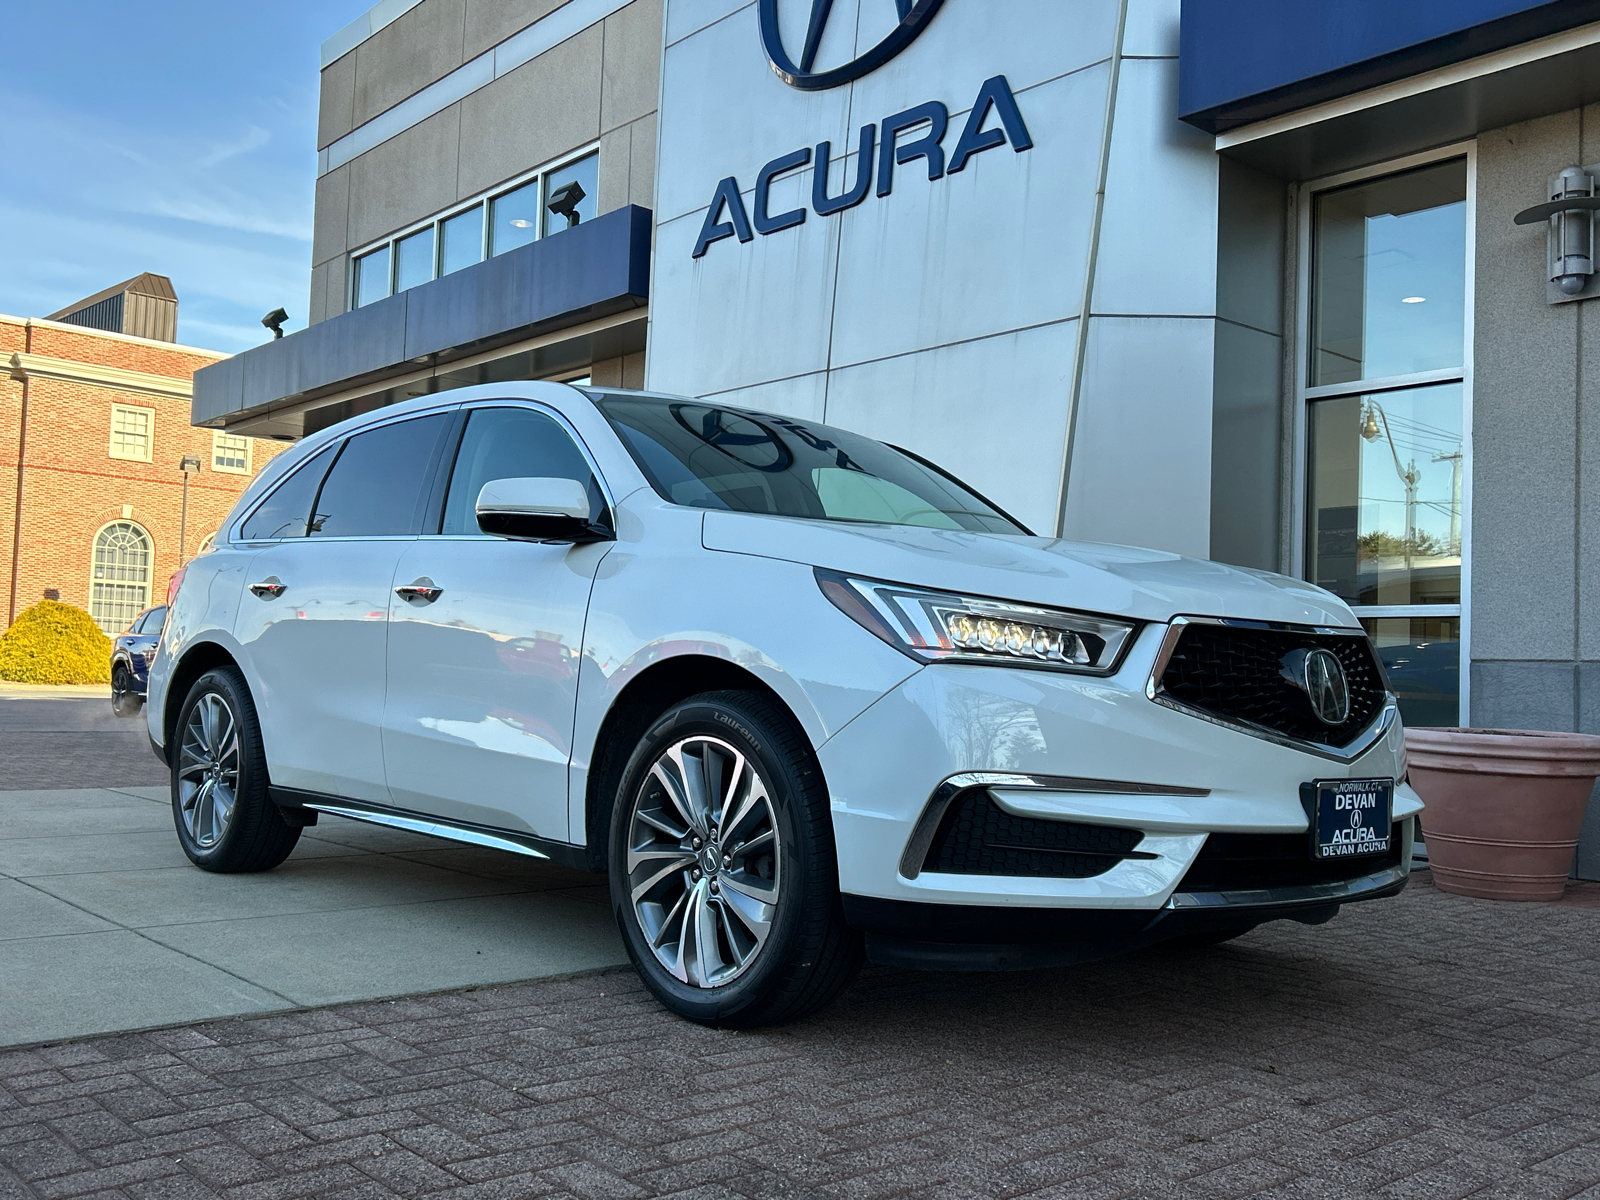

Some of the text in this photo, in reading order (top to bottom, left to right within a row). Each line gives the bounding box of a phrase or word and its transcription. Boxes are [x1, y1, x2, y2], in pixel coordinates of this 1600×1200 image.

[692, 74, 1033, 258] ACURA
[1335, 793, 1376, 810] DEVAN
[1332, 827, 1376, 844] ACURA
[1322, 841, 1387, 857] DEVAN ACURA
